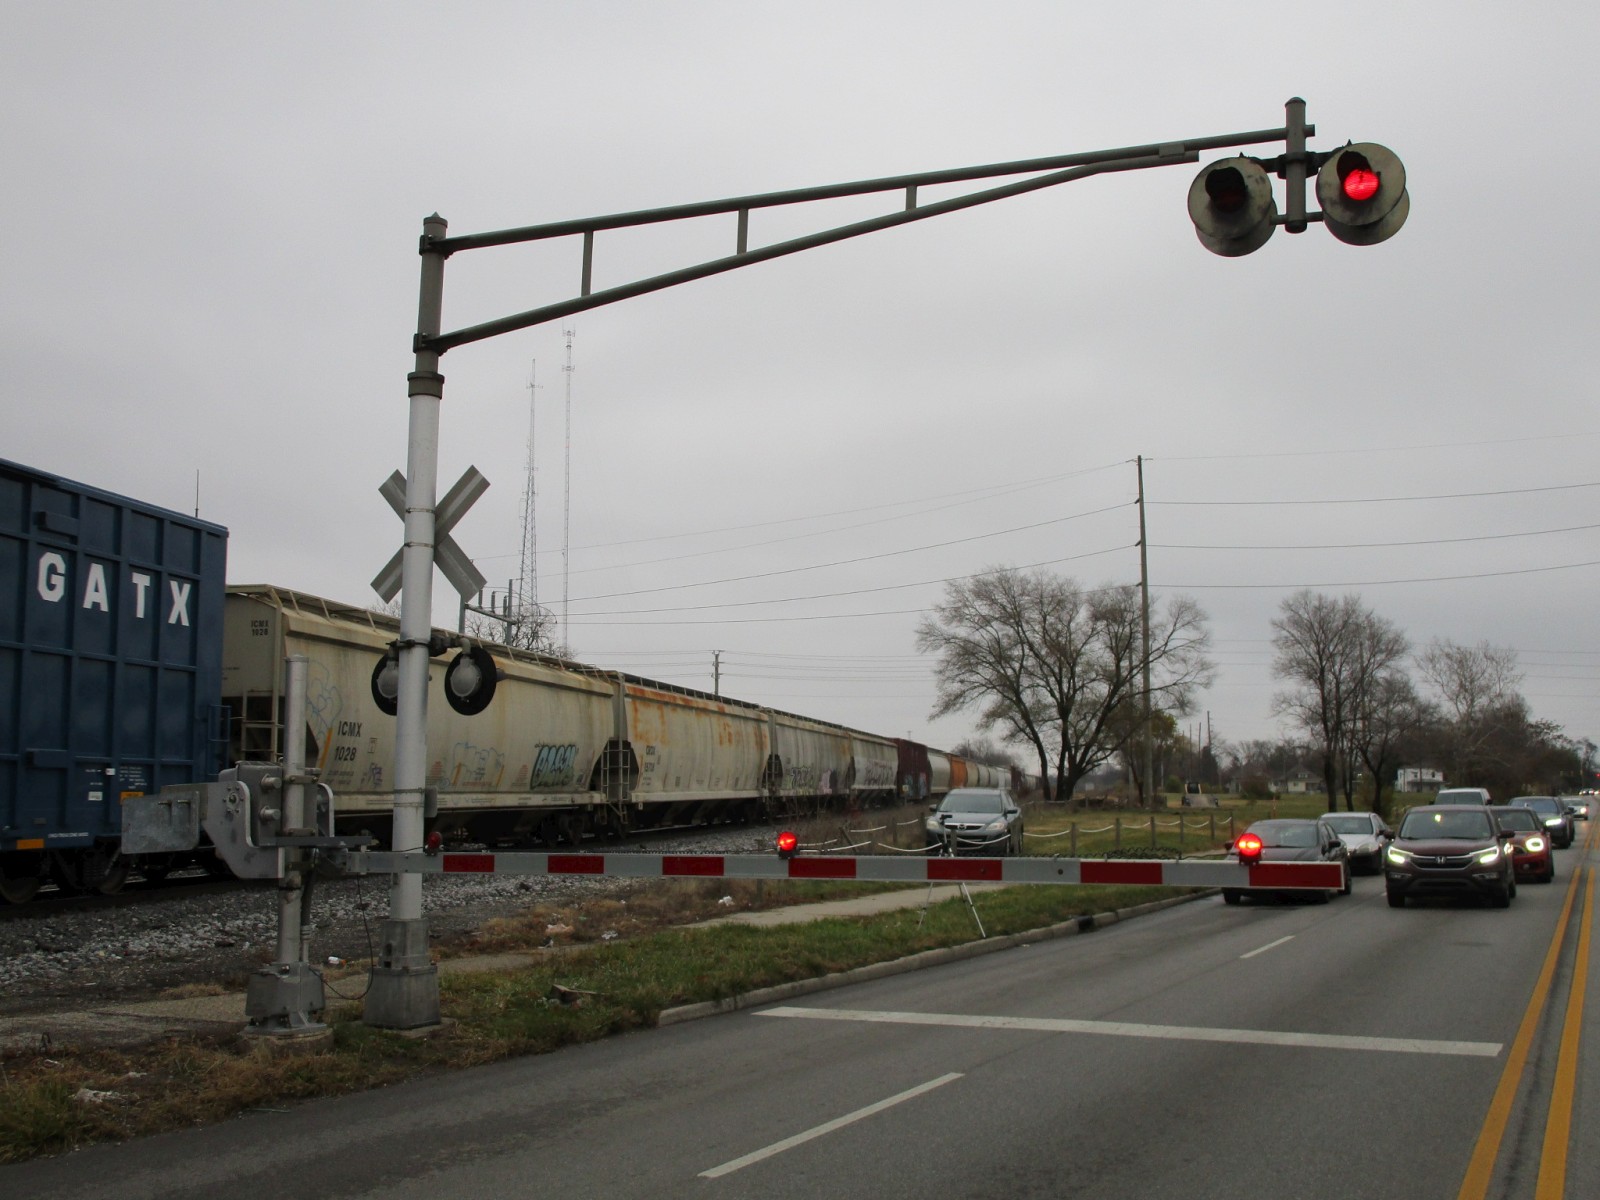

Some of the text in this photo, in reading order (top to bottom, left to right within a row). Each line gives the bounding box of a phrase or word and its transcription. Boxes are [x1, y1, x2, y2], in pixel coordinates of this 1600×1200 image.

[37, 551, 191, 627] GATX
[251, 620, 269, 628] ICMX
[251, 628, 269, 636] 1028
[337, 720, 363, 738] ICMX
[334, 745, 357, 762] 1028
